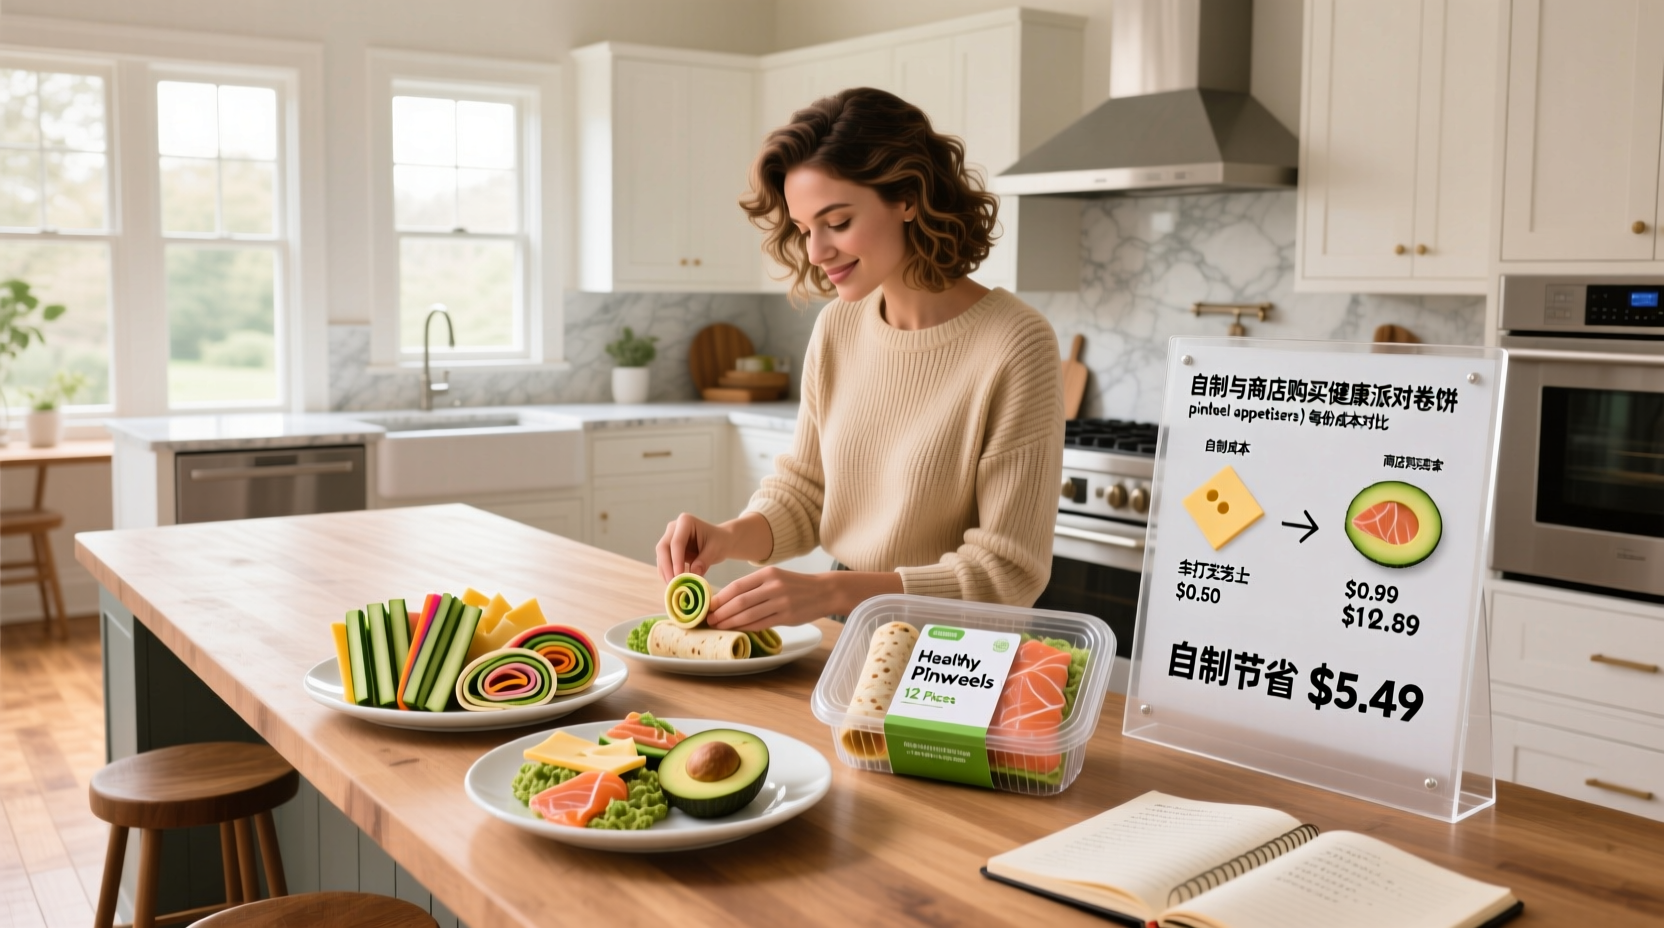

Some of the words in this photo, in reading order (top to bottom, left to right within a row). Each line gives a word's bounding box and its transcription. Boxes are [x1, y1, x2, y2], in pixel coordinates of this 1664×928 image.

[1190, 372, 1459, 414] 自制与商店购买健康派对卷饼
[1175, 581, 1222, 604] $0.50
[1344, 578, 1400, 604] $0.99
[1341, 603, 1421, 637] $12.89
[904, 686, 921, 700] 12
[1168, 640, 1299, 701] 自制节省
[1307, 662, 1425, 723] $5.49
